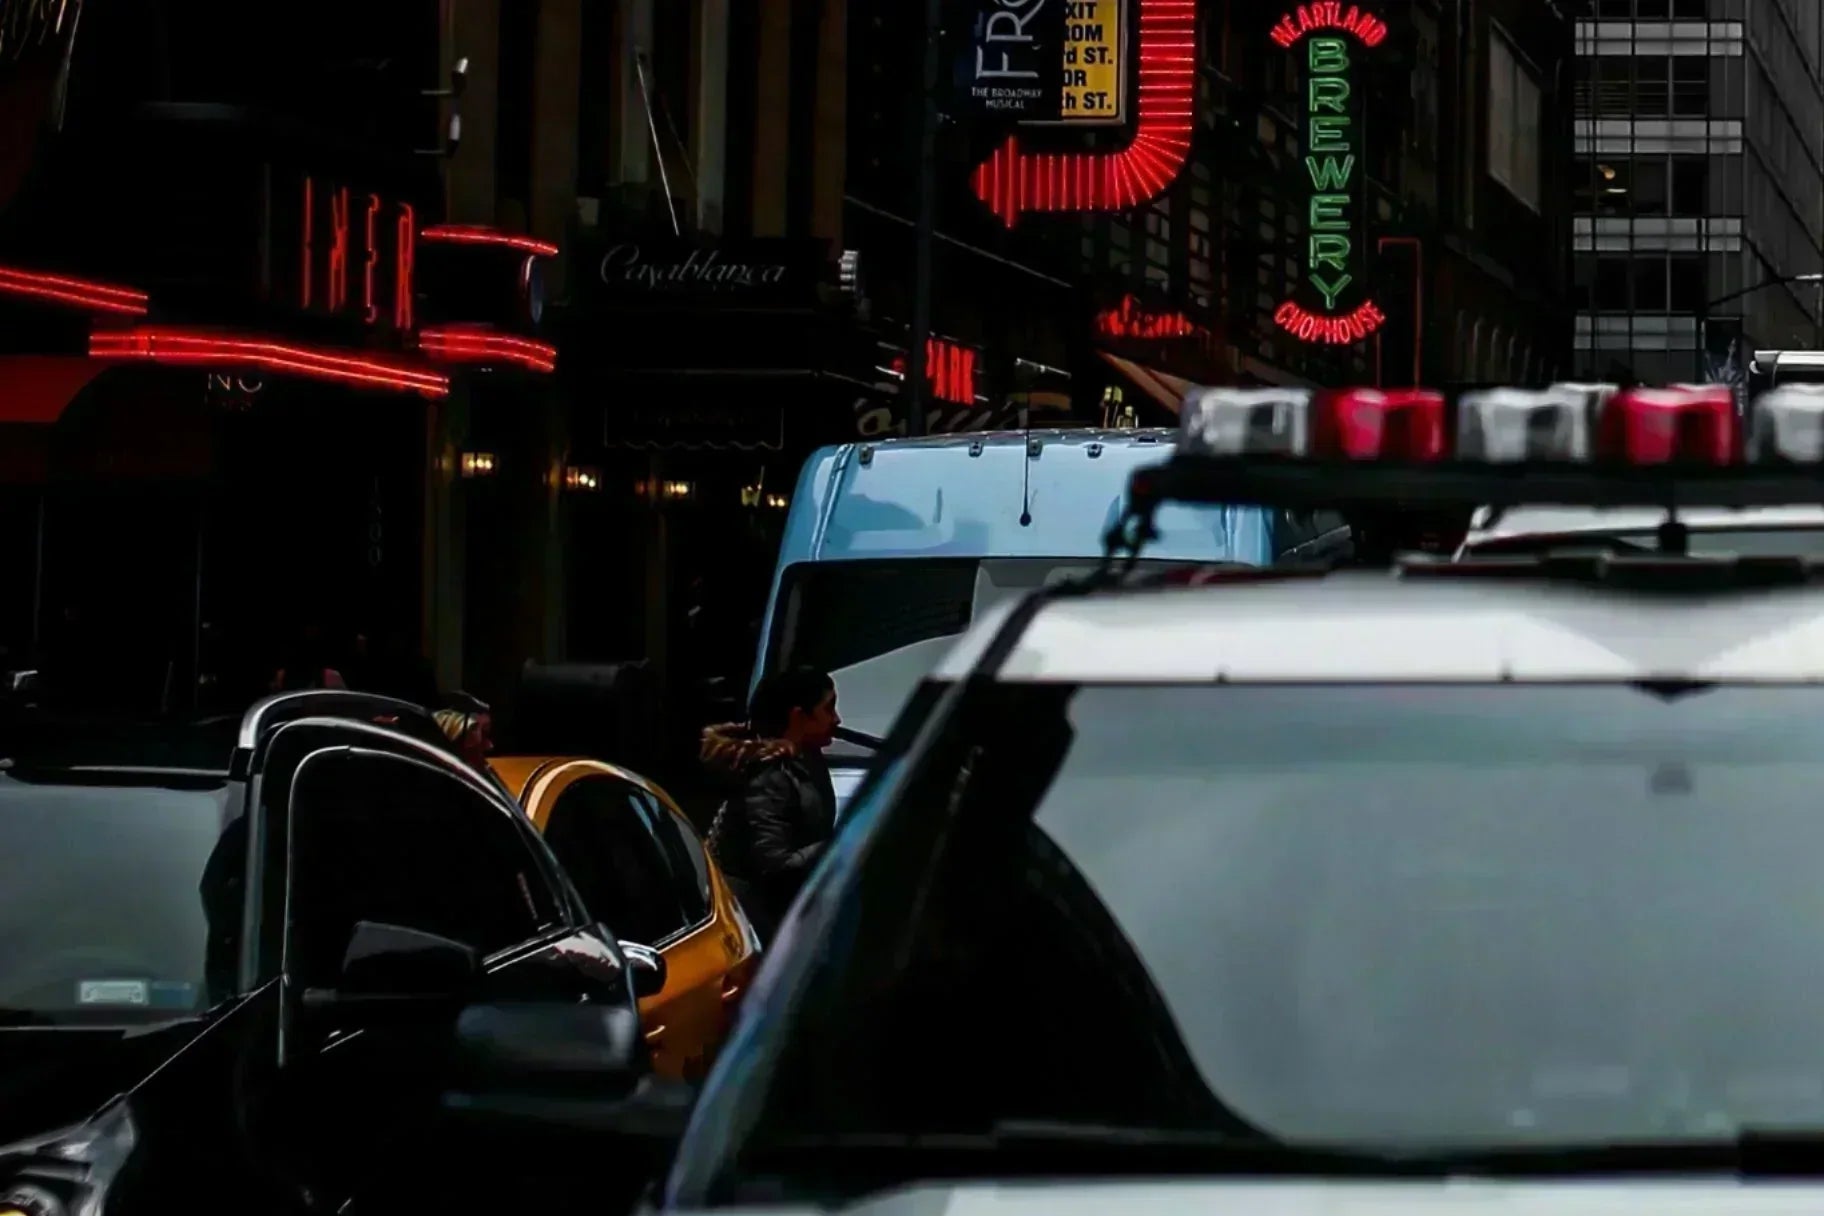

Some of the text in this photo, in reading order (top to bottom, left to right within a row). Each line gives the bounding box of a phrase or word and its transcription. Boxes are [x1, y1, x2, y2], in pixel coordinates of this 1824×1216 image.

[976, 0, 1041, 80] FR
[1270, 1, 1388, 47] HEARTLAND
[1084, 47, 1114, 65] ST.
[985, 99, 1025, 110] MUSICAL
[991, 87, 1044, 99] BROADWAY
[1083, 91, 1112, 110] ST.
[1305, 37, 1355, 309] BREWERY
[1273, 299, 1387, 344] CHOPHOUSE
